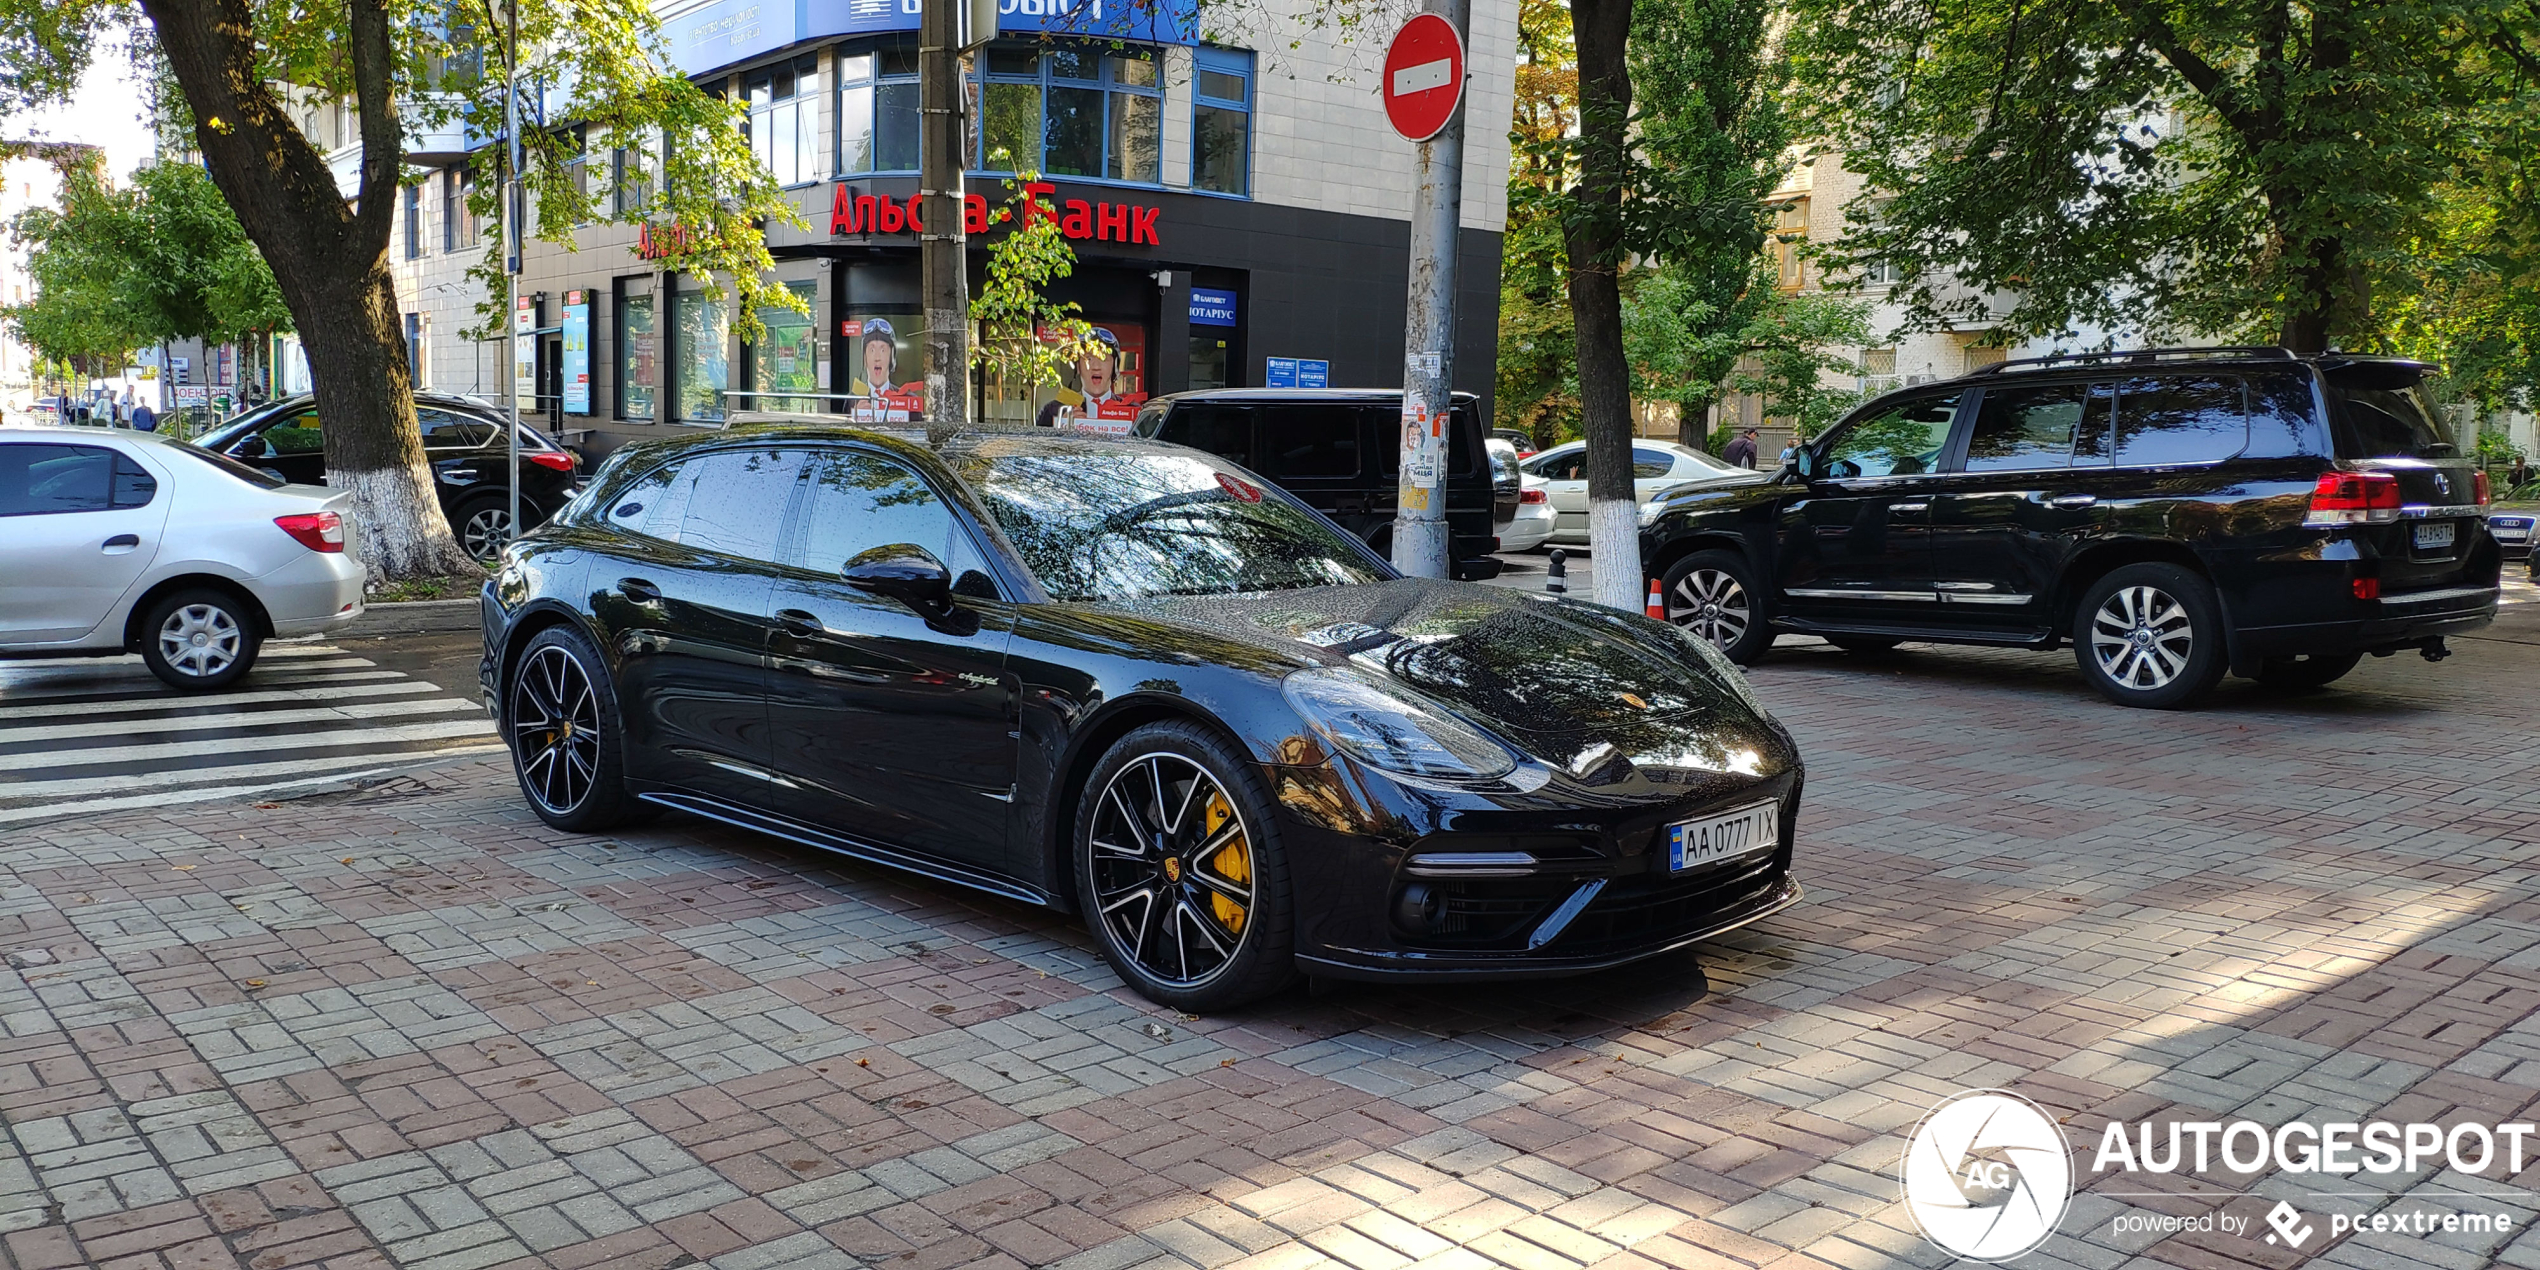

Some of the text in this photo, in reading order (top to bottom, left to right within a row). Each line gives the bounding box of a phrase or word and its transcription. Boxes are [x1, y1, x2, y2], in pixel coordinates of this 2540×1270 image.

[830, 182, 1160, 246] Альа-Банк
[1111, 425, 1129, 433] все!
[1672, 808, 1774, 864] UA AA 0777 IX
